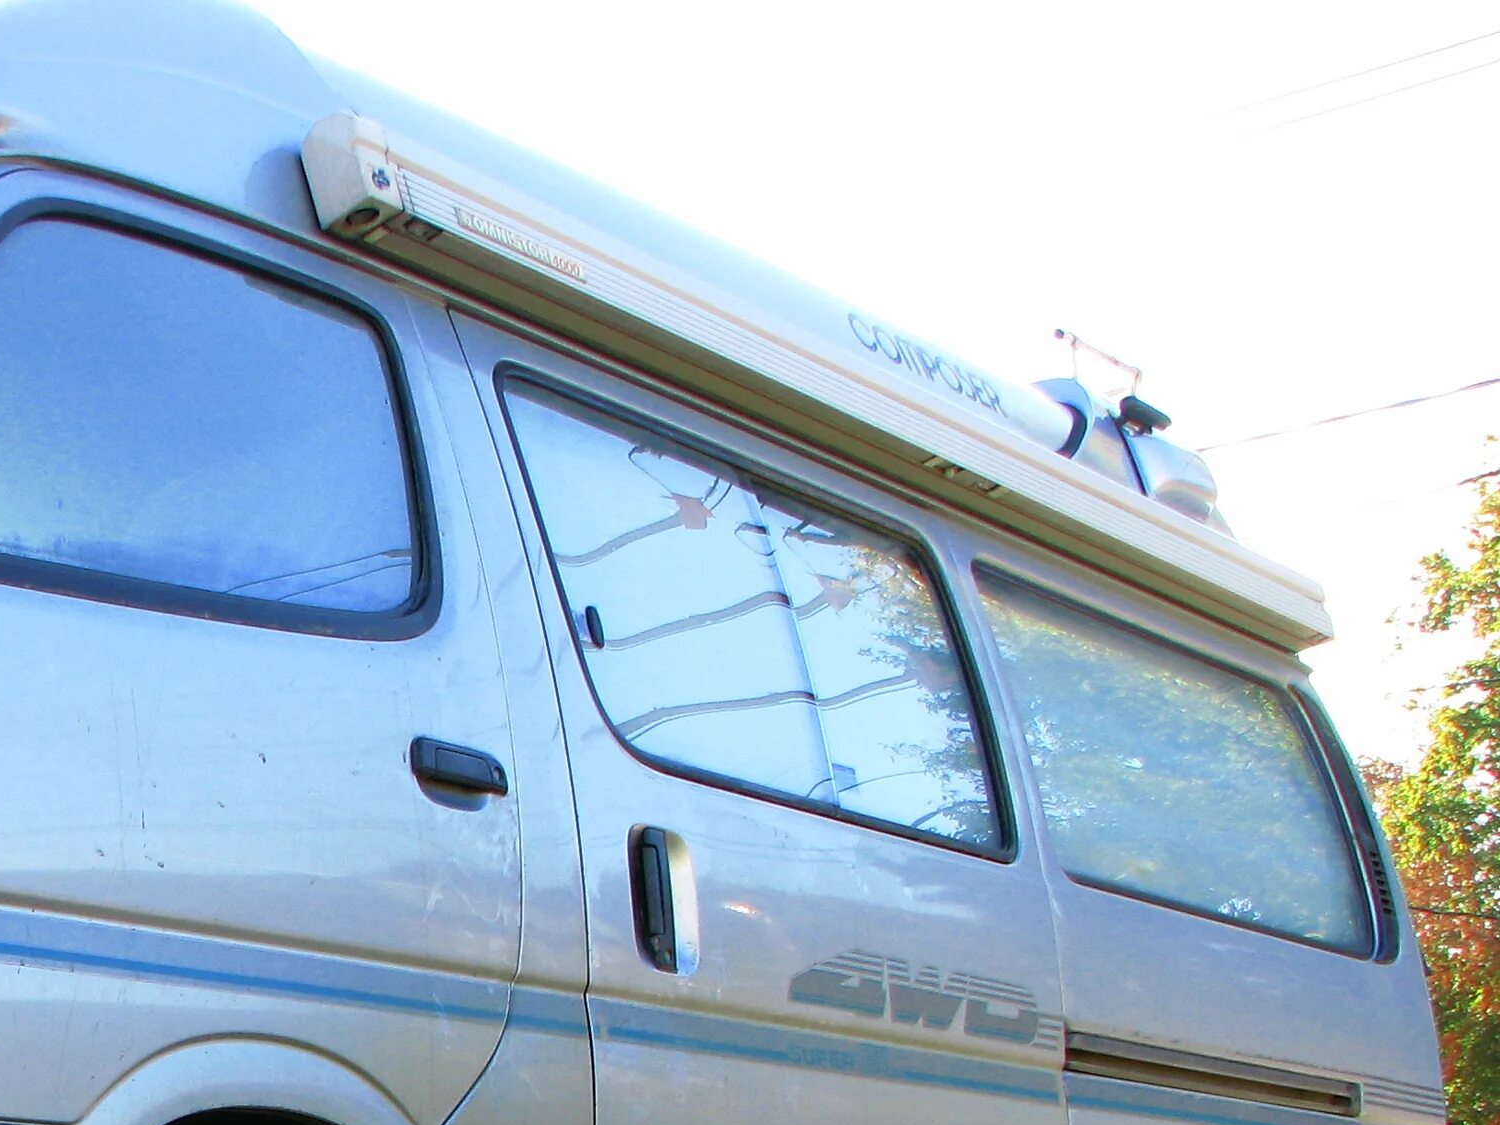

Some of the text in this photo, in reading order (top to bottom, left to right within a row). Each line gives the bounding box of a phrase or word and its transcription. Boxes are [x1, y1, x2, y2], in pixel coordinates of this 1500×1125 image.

[472, 215, 582, 277] OMNISTOR 4000
[847, 312, 1008, 418] COMPOSER
[788, 951, 1038, 1045] 4WD
